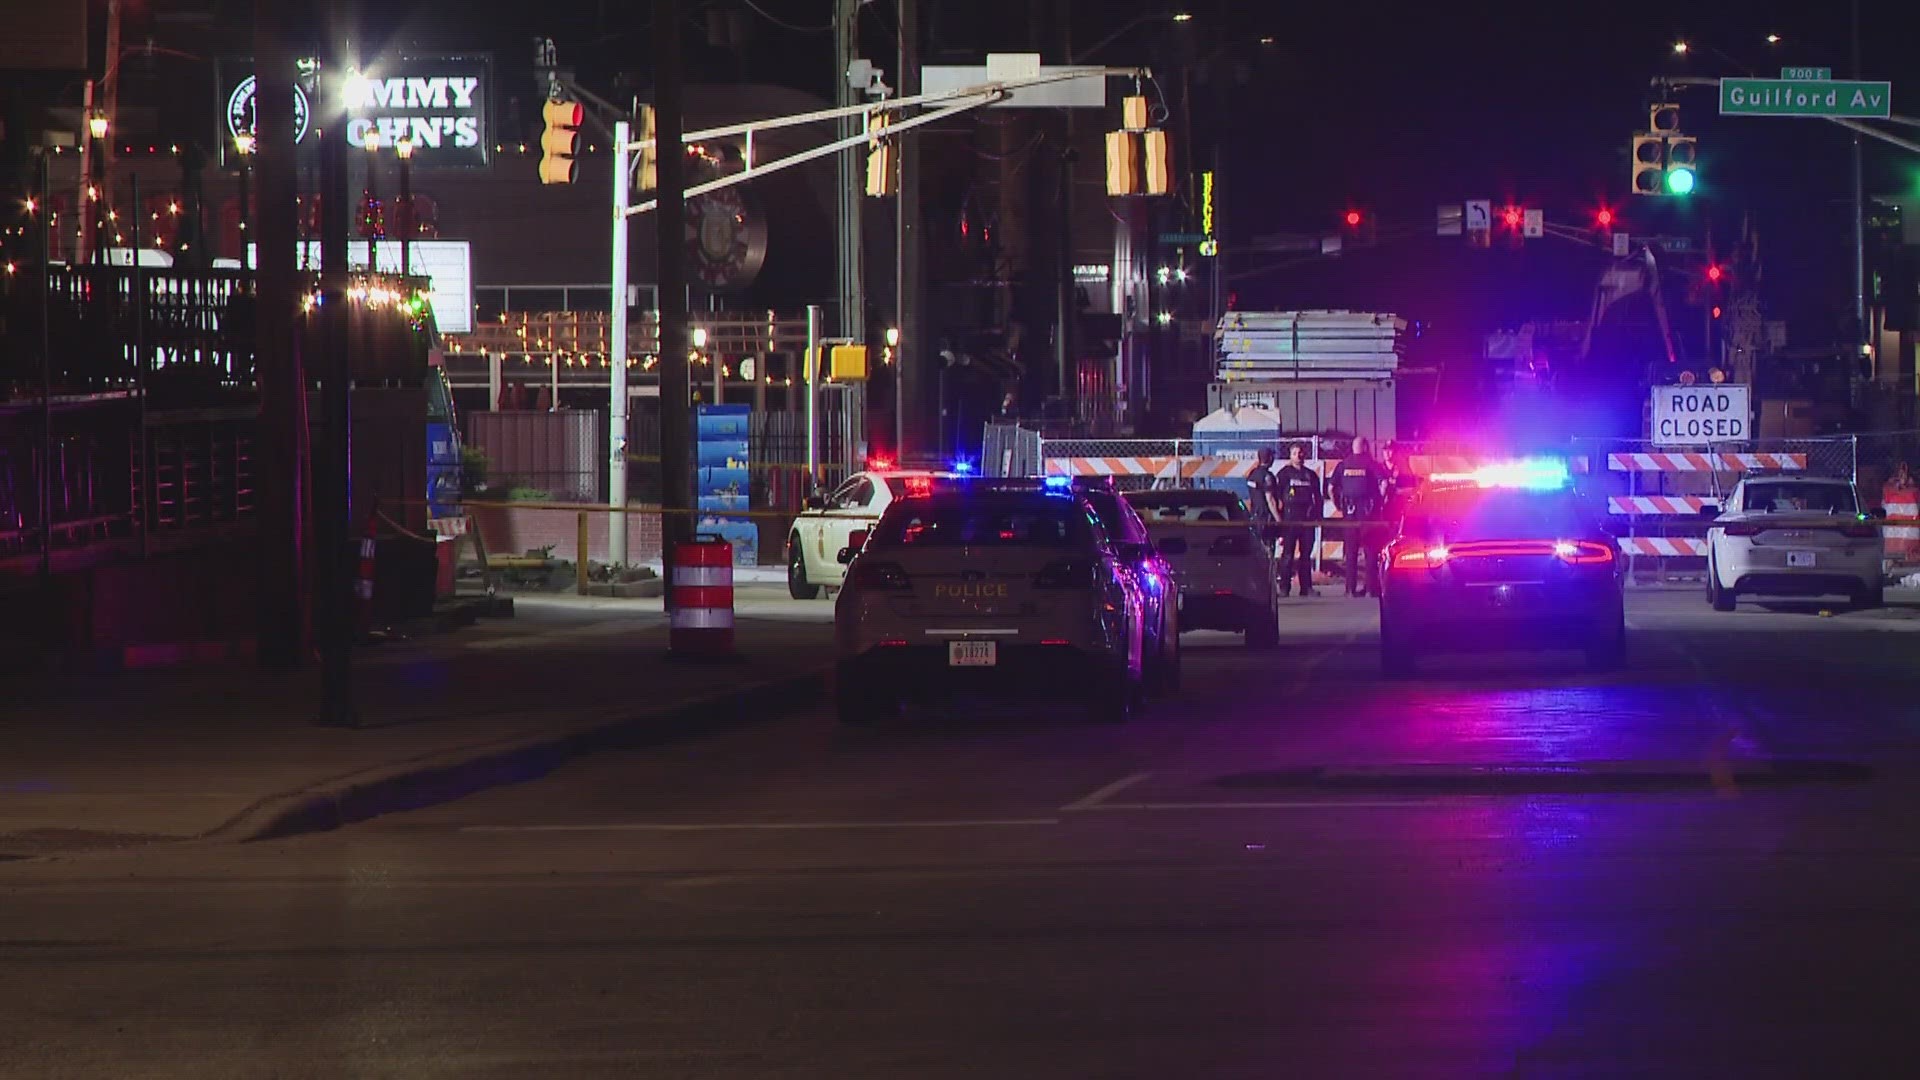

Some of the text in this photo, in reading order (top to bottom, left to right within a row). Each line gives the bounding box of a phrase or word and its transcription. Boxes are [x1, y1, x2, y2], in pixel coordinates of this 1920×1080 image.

[1788, 68, 1824, 80] 900 E
[346, 76, 479, 109] MMY
[1729, 86, 1882, 109] Guilford Av
[346, 116, 479, 149] OHN'S
[1672, 394, 1730, 412] ROAD
[1660, 418, 1742, 437] CLOSED
[935, 583, 1008, 598] POLICE
